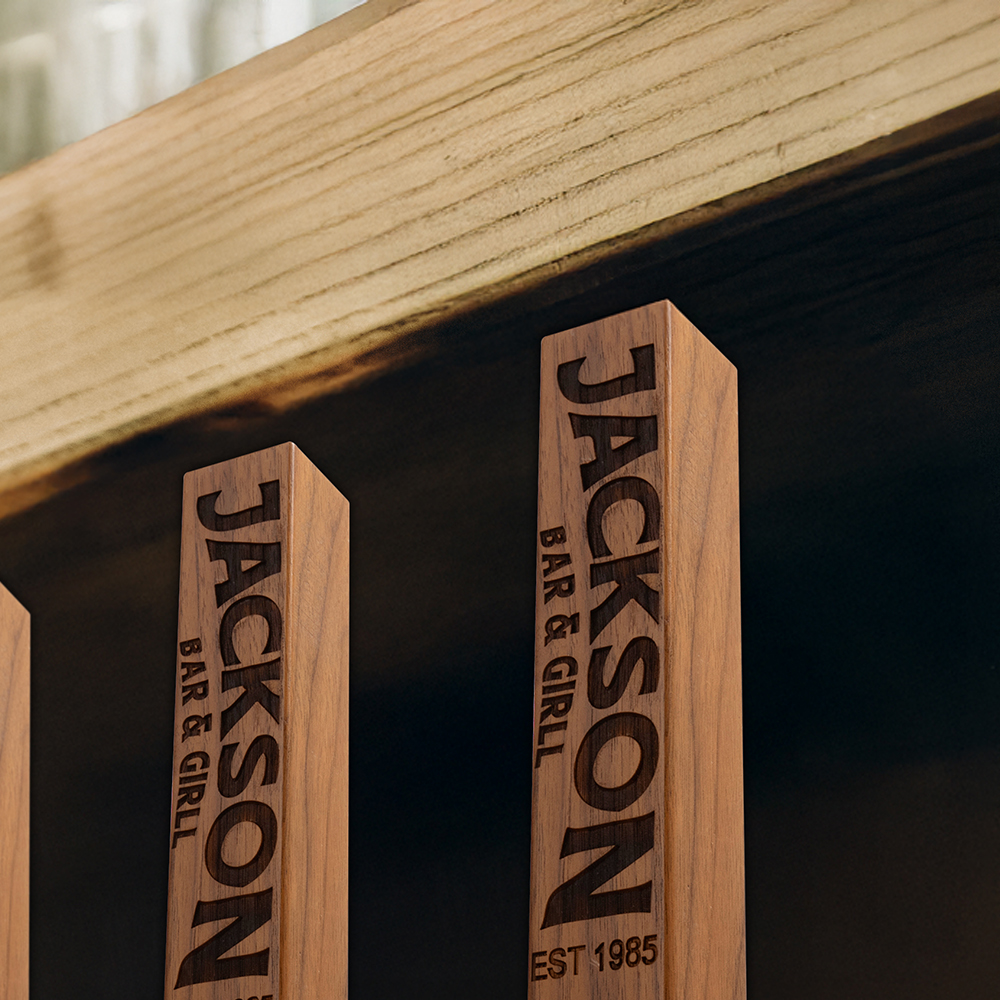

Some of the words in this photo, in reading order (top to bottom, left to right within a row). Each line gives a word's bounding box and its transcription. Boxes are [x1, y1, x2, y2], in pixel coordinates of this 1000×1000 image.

[540, 526, 576, 604] BAR
[540, 343, 660, 930] JACKSON
[544, 612, 580, 647] &
[179, 637, 210, 706] BAR
[174, 479, 282, 990] JACKSON
[181, 713, 213, 743] &
[534, 655, 579, 769] GIRLL
[171, 751, 211, 850] GIRLL
[531, 945, 586, 982] EST
[595, 934, 659, 971] 1985
